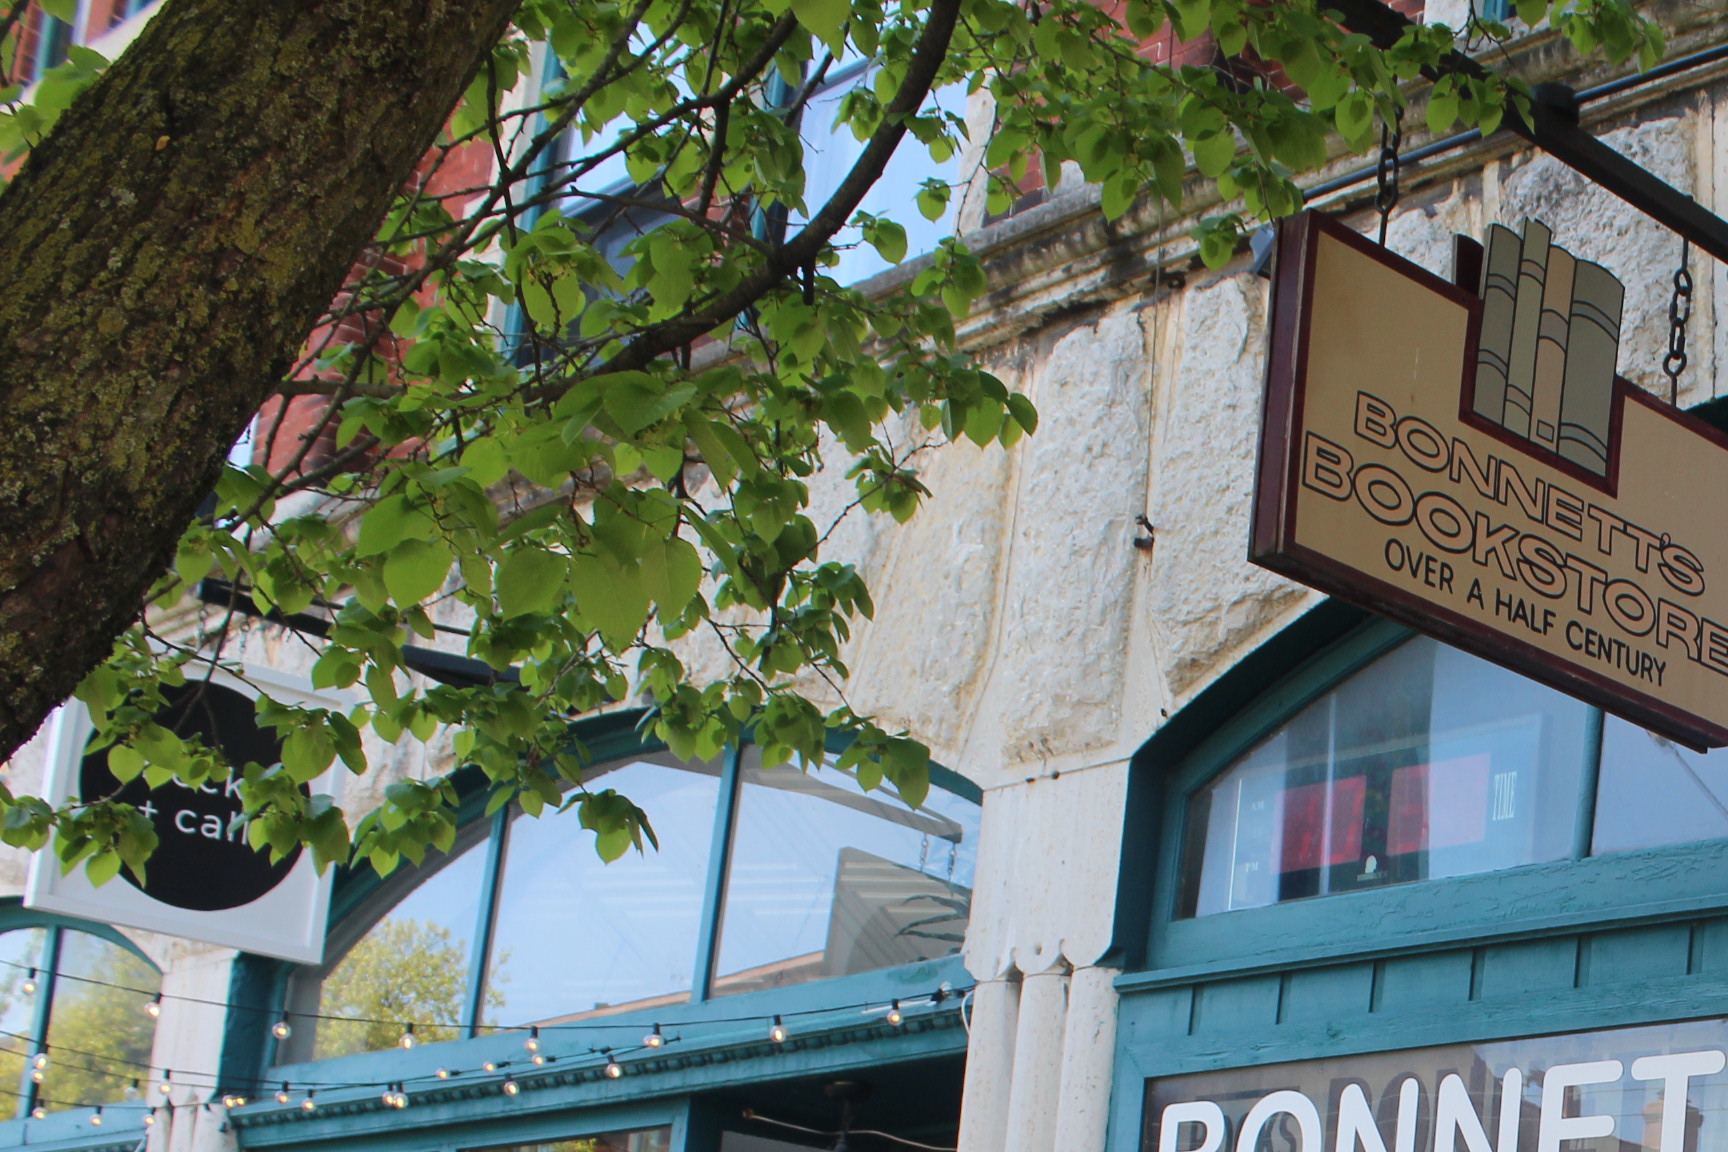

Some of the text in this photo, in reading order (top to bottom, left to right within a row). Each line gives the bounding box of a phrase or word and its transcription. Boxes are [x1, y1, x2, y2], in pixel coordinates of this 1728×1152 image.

[1355, 391, 1705, 597] BONNETT'S
[1385, 538, 1667, 688] OVER A HALF CENTURY
[1492, 770, 1518, 822] TIME
